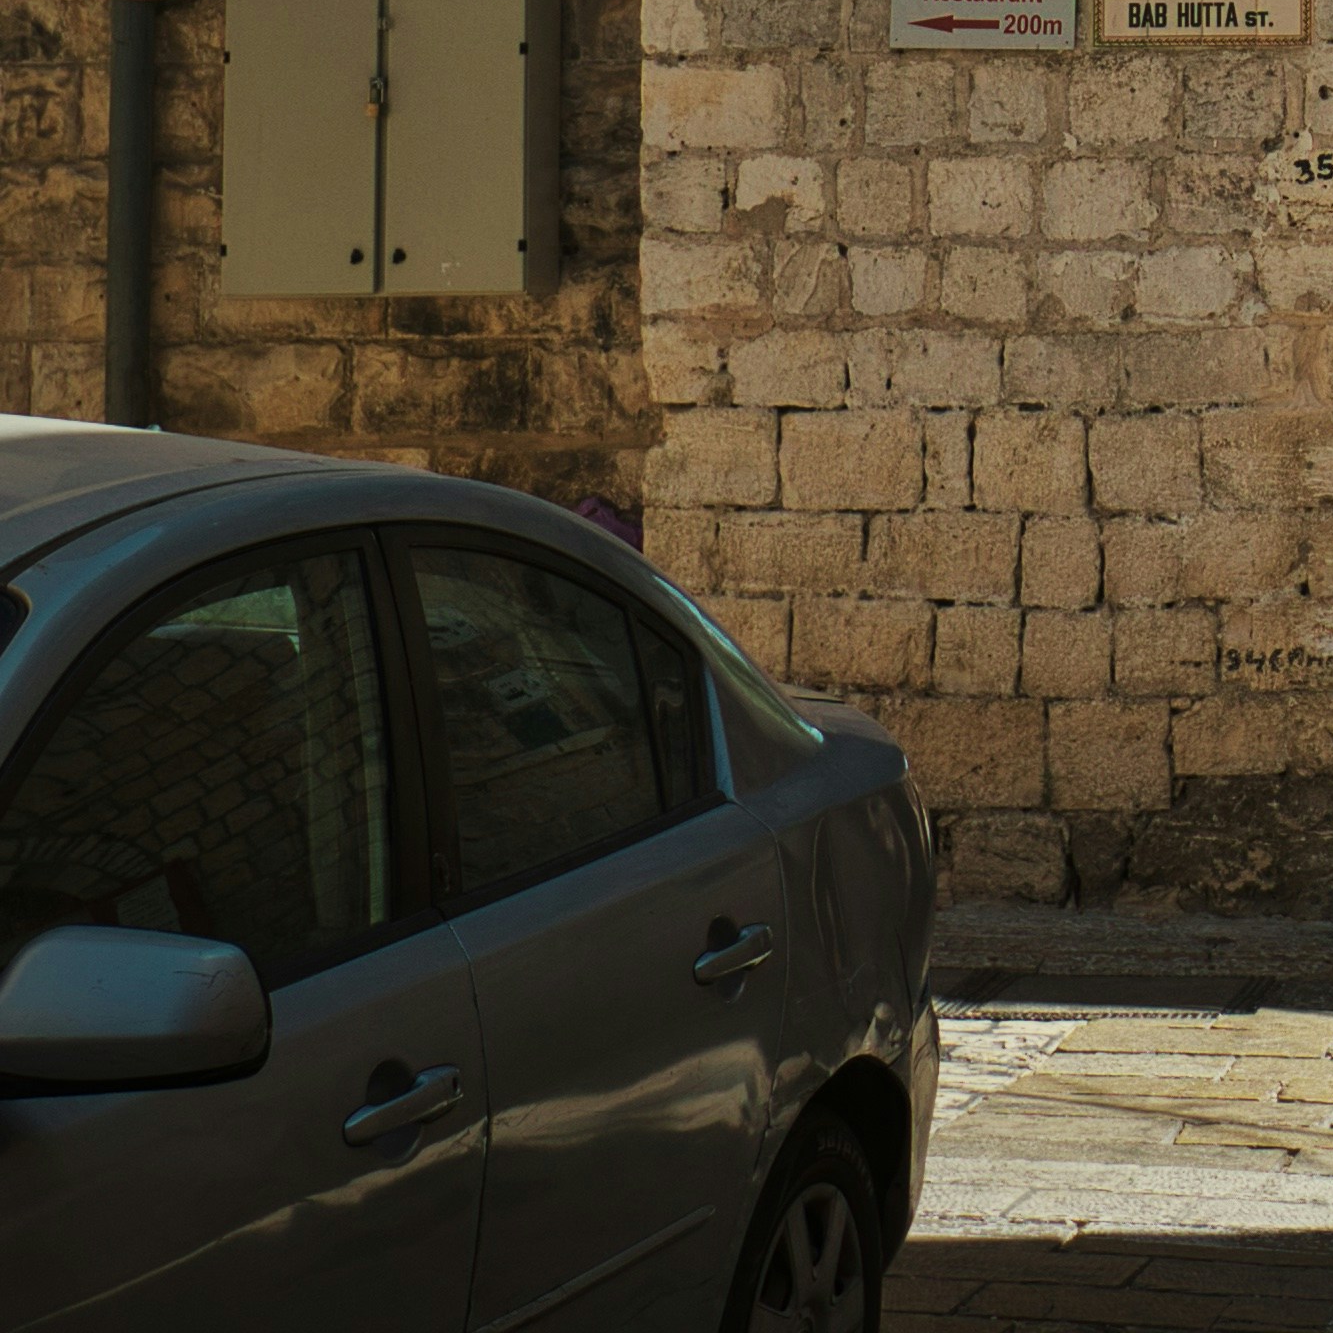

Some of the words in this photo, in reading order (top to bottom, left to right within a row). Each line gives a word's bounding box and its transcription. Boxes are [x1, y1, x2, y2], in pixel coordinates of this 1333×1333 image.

[1003, 14, 1062, 35] 200m
[1128, 2, 1168, 29] BAB
[1177, 1, 1239, 28] HUTTA
[1244, 10, 1274, 28] ST.
